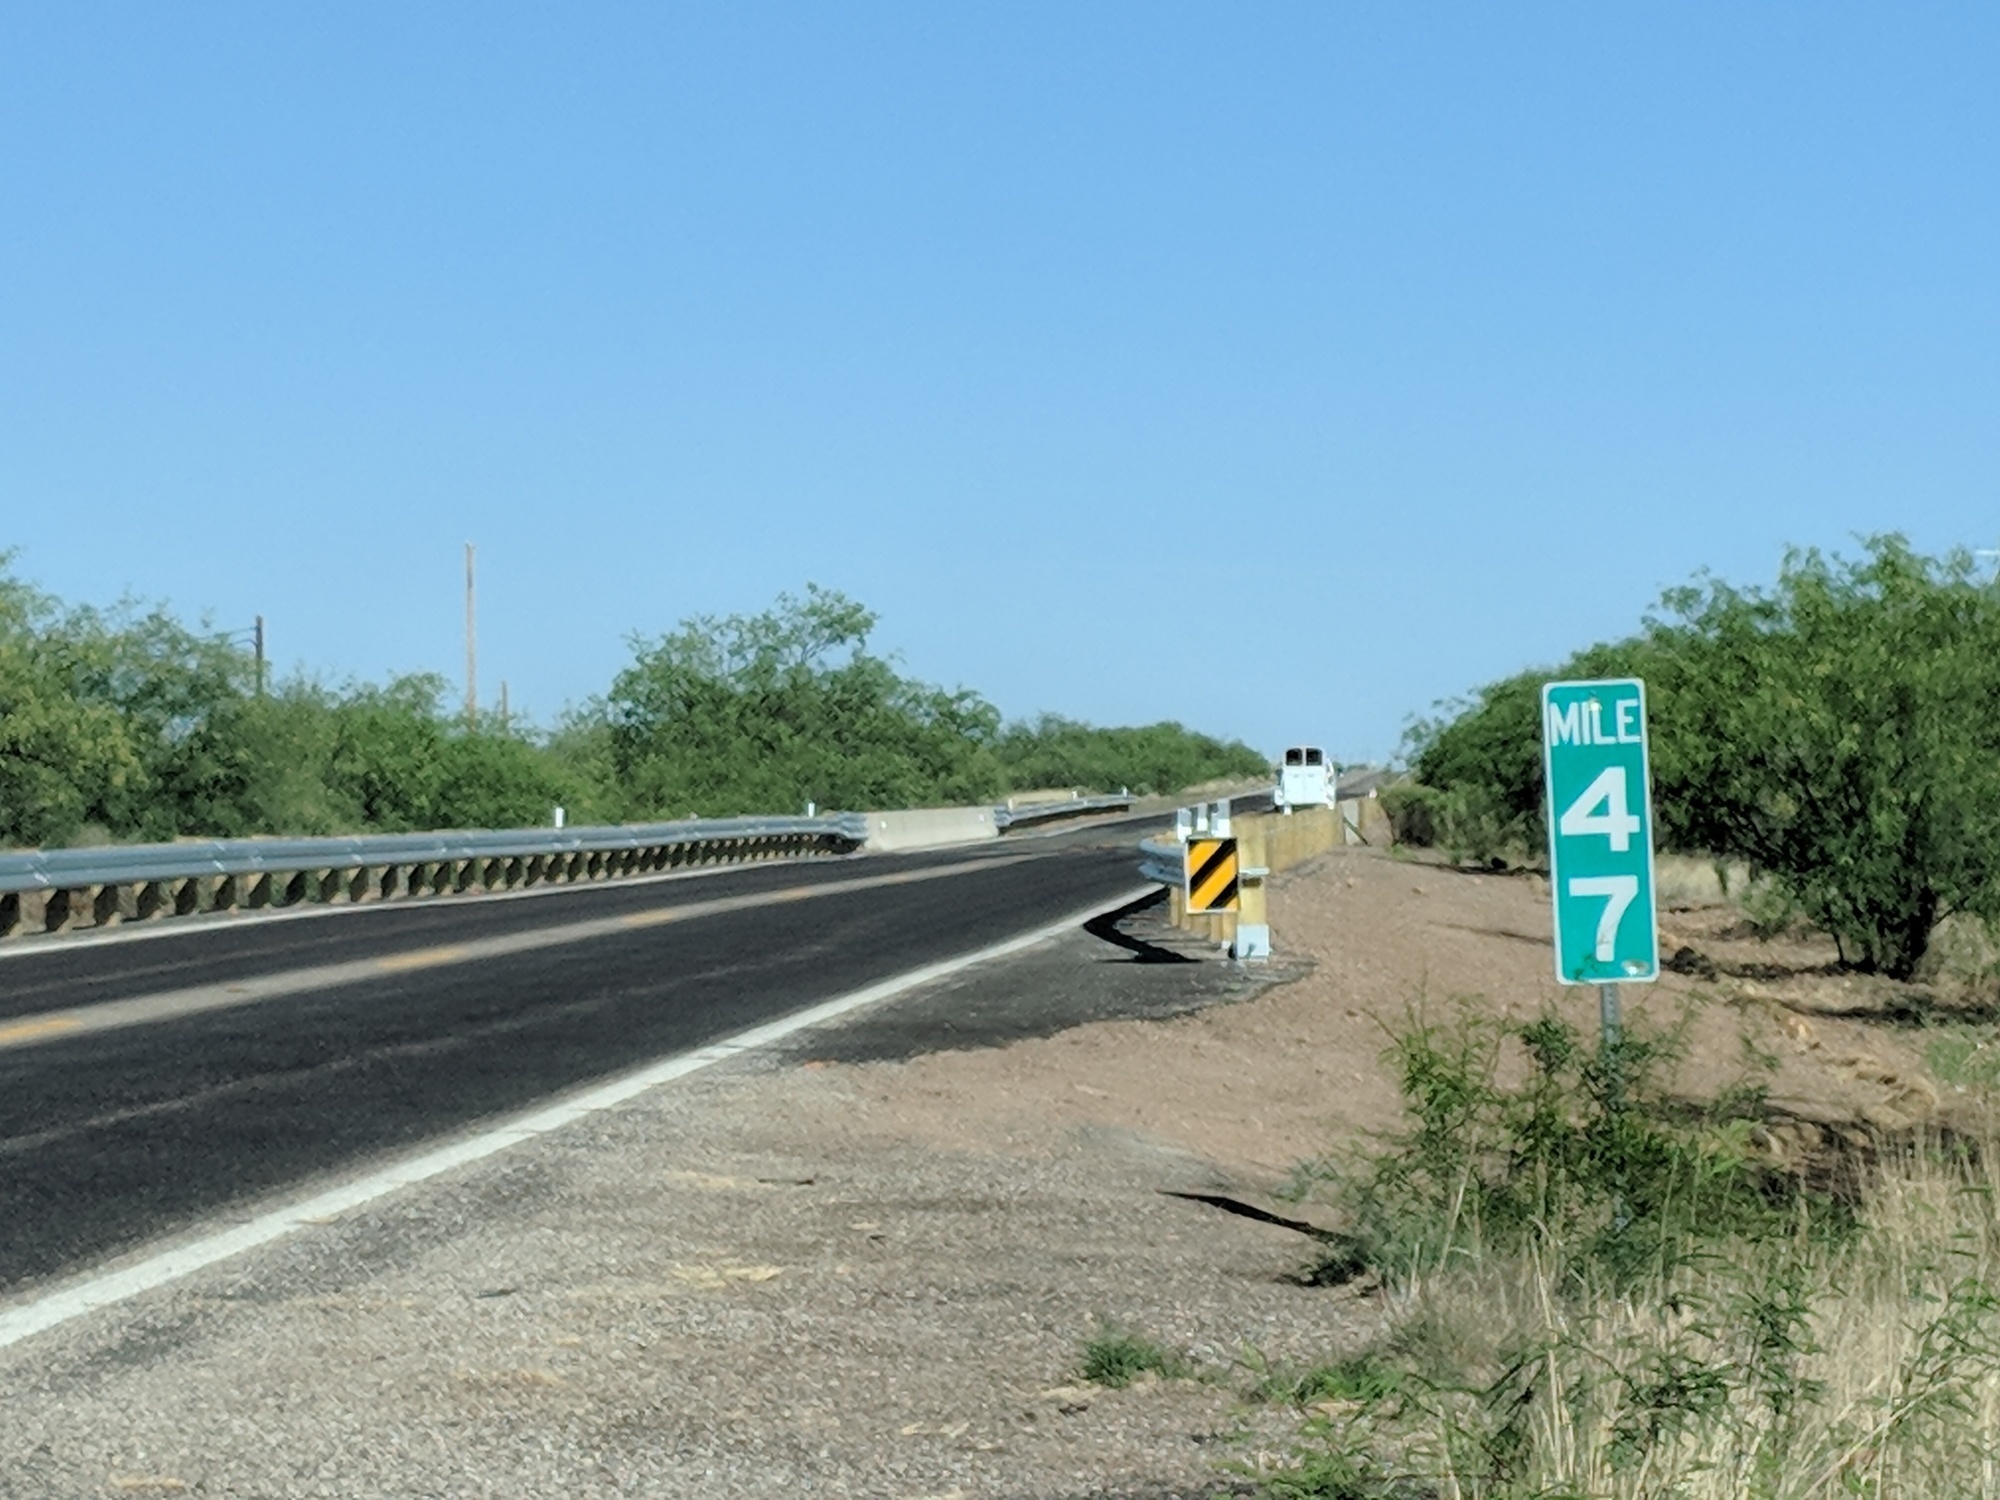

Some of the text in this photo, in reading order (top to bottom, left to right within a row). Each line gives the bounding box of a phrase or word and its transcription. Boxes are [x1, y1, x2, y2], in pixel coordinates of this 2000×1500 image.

[1550, 699, 1641, 746] MILE
[1560, 766, 1640, 851] 4
[1568, 875, 1639, 962] 7
